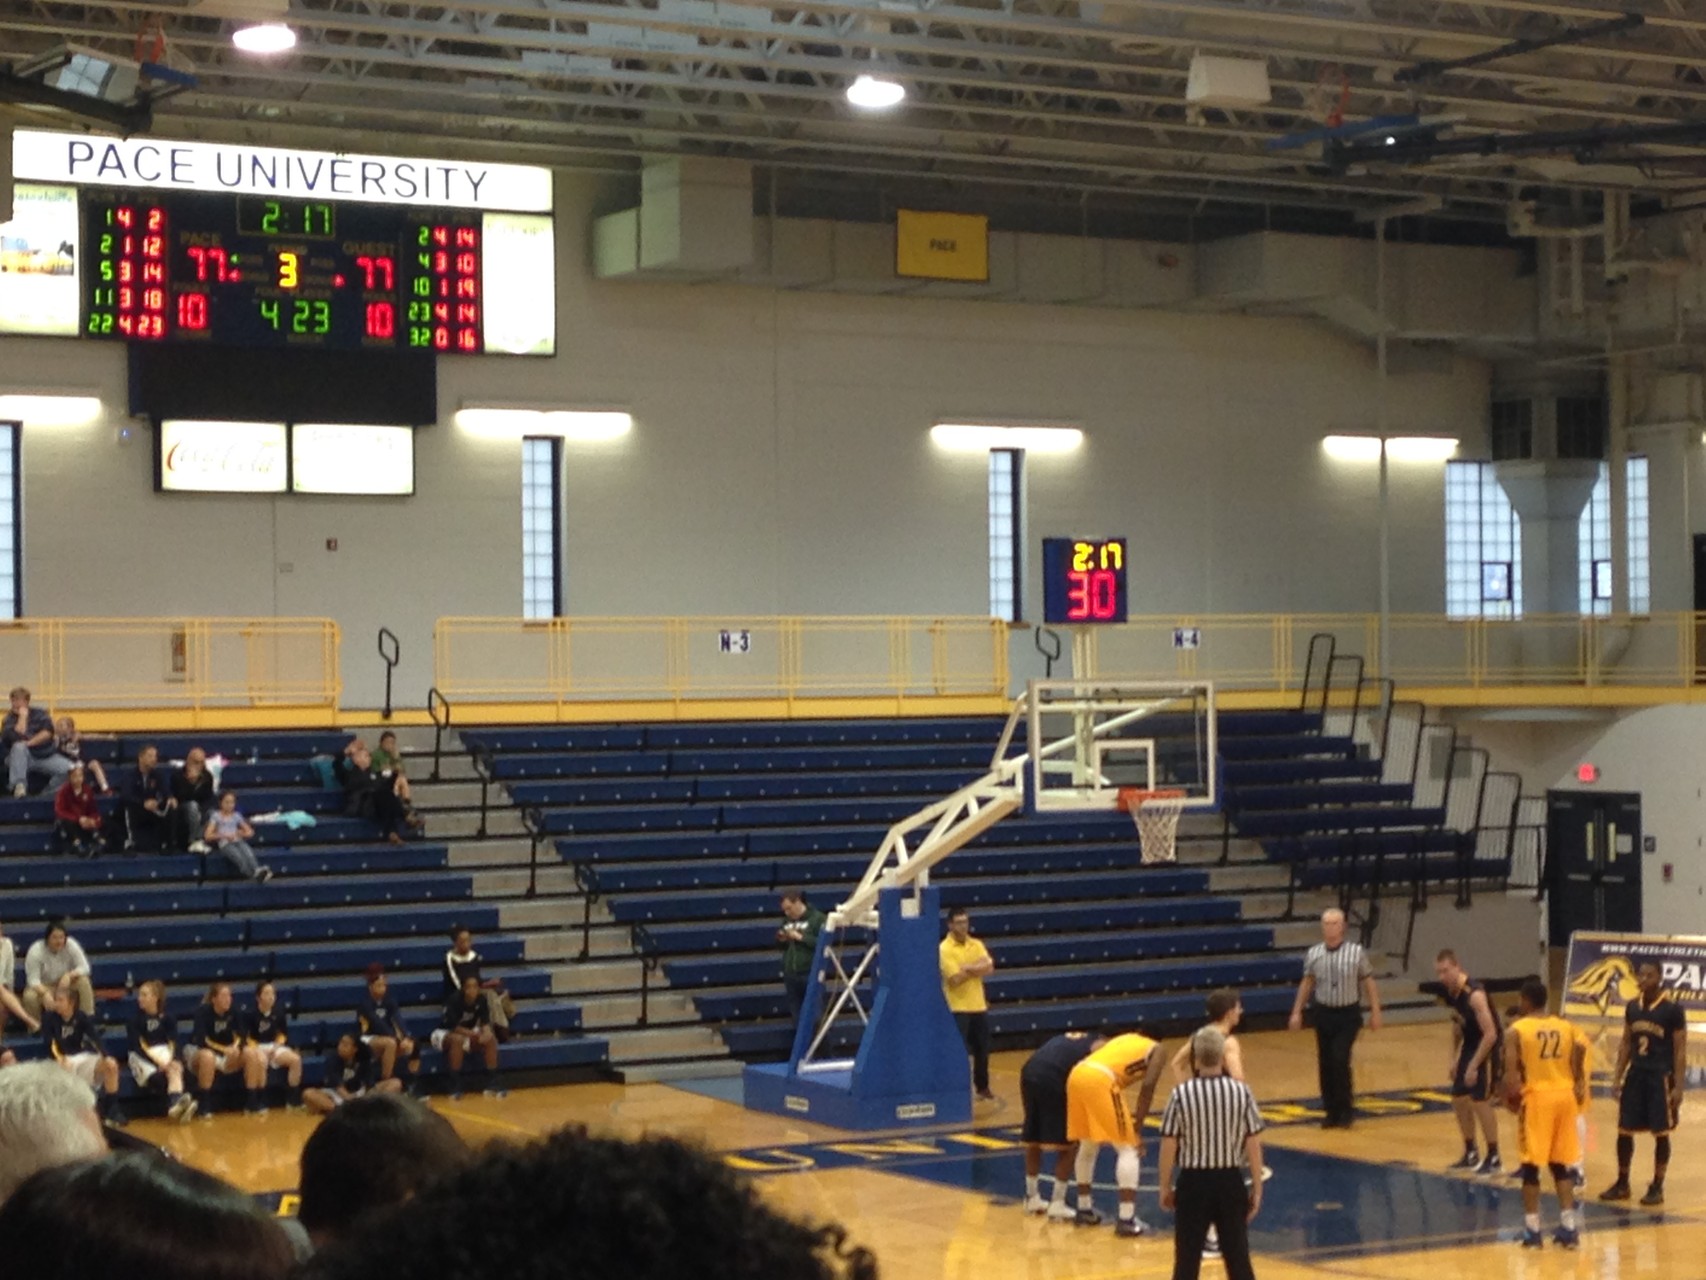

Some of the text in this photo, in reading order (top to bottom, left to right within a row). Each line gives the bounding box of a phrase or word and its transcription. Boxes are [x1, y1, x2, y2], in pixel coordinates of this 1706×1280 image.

[68, 140, 487, 202] PACE UNIVERSITY
[106, 208, 161, 231] 1 4 2
[261, 201, 330, 234] 2:17
[101, 234, 161, 258] 2 1 12
[418, 225, 429, 246] 2
[434, 226, 447, 246] 4
[456, 229, 475, 247] 14
[101, 260, 162, 282] 5 3 14
[187, 248, 226, 281] 77
[279, 252, 298, 287] 3
[356, 257, 394, 289] 77
[418, 252, 430, 269] 4
[456, 253, 475, 274] 10
[95, 288, 113, 306] 11
[119, 288, 132, 309] 3
[414, 277, 430, 296] 10
[441, 277, 448, 297] 1
[178, 293, 206, 330] 10
[261, 301, 329, 334] 4 23
[366, 303, 394, 337] 10
[408, 302, 475, 323] 23 4 14
[89, 314, 113, 333] 22
[118, 315, 132, 335] 4
[138, 315, 163, 338] 23
[410, 327, 431, 347] 32
[435, 327, 448, 349] 0
[457, 328, 475, 350] 16
[1073, 542, 1122, 572] 2:17
[1067, 571, 1117, 619] 30
[720, 630, 749, 652] N-3
[1174, 629, 1198, 647] N-4
[1660, 962, 1706, 990] PA
[1536, 1030, 1562, 1060] 22
[1638, 1036, 1649, 1056] 2
